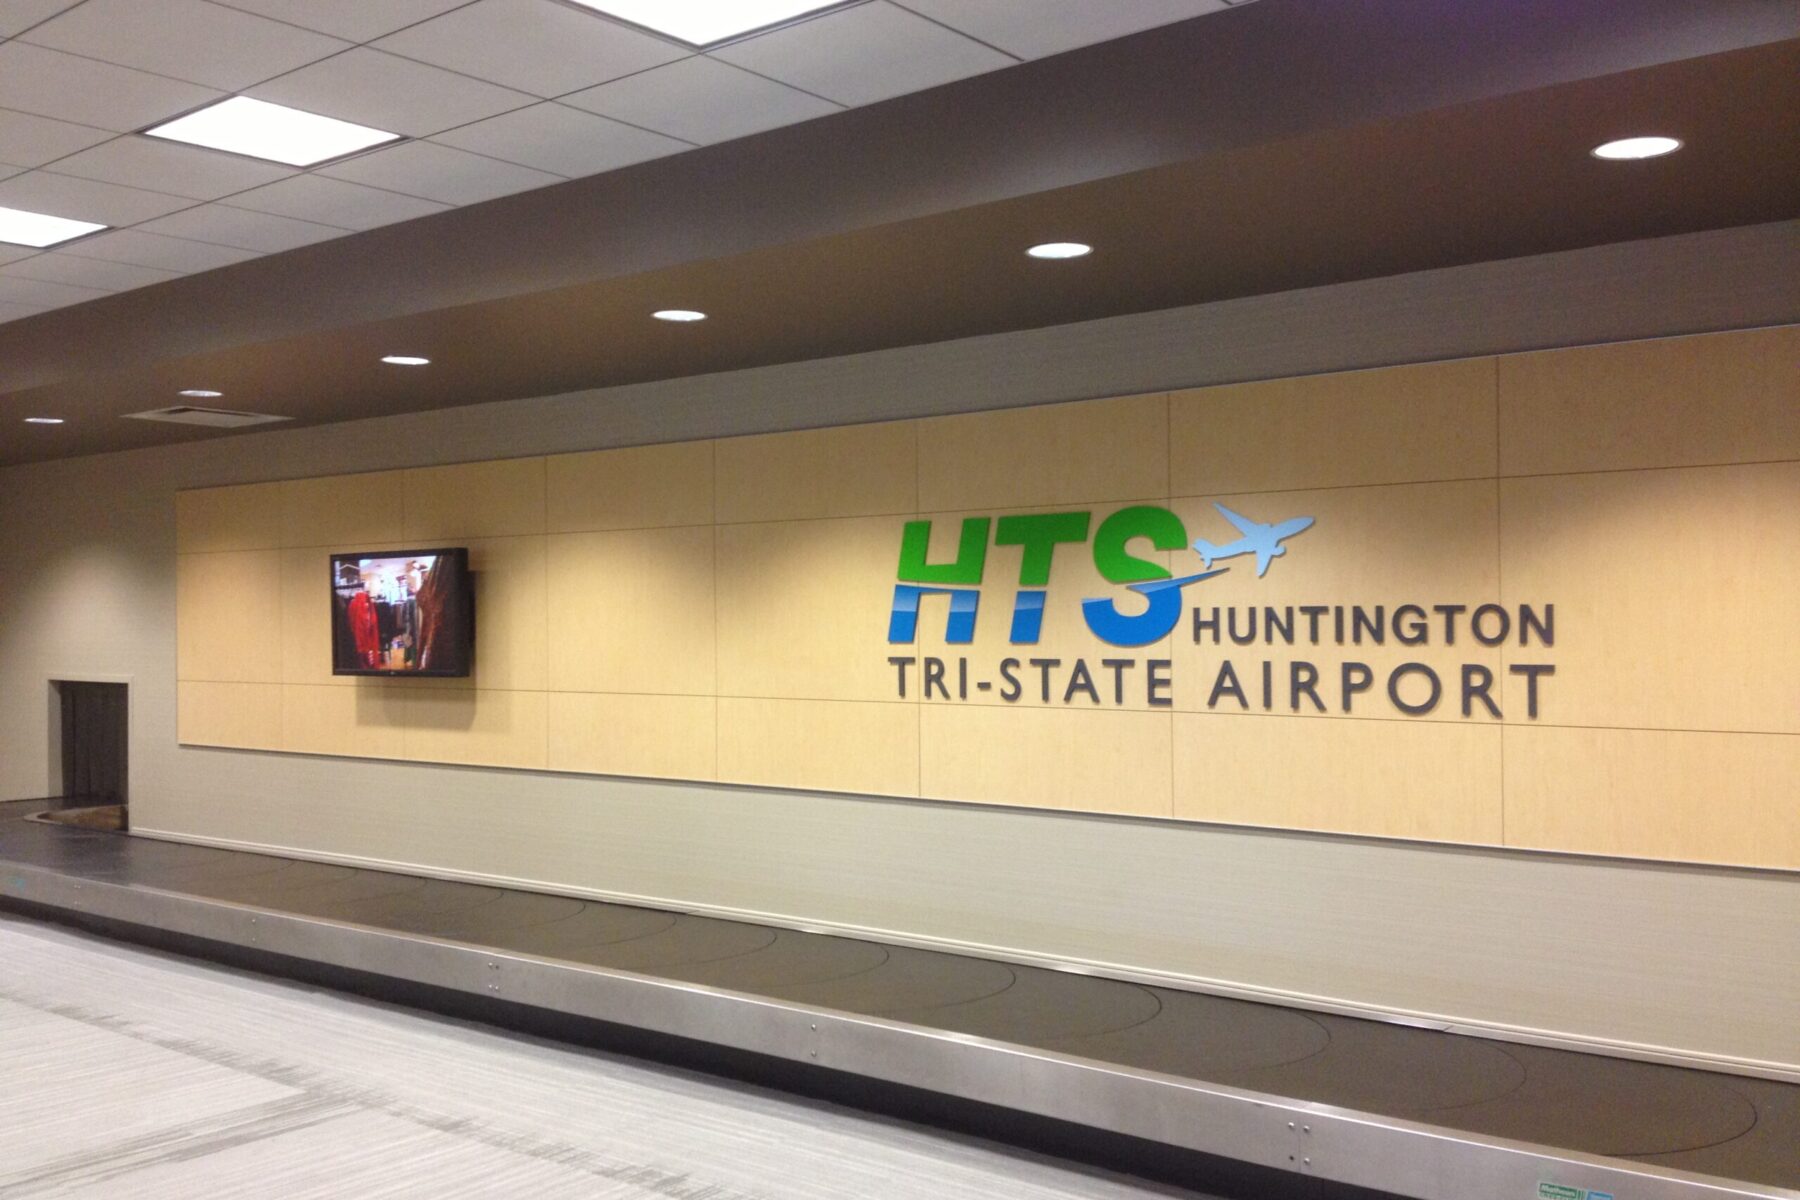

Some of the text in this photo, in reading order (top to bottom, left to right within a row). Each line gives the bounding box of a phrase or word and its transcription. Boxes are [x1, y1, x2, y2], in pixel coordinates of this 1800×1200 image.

[888, 505, 1188, 647] HTS
[1193, 603, 1555, 646] HUNTINGTON
[887, 656, 1556, 720] TRI-STATE AIRPORT
